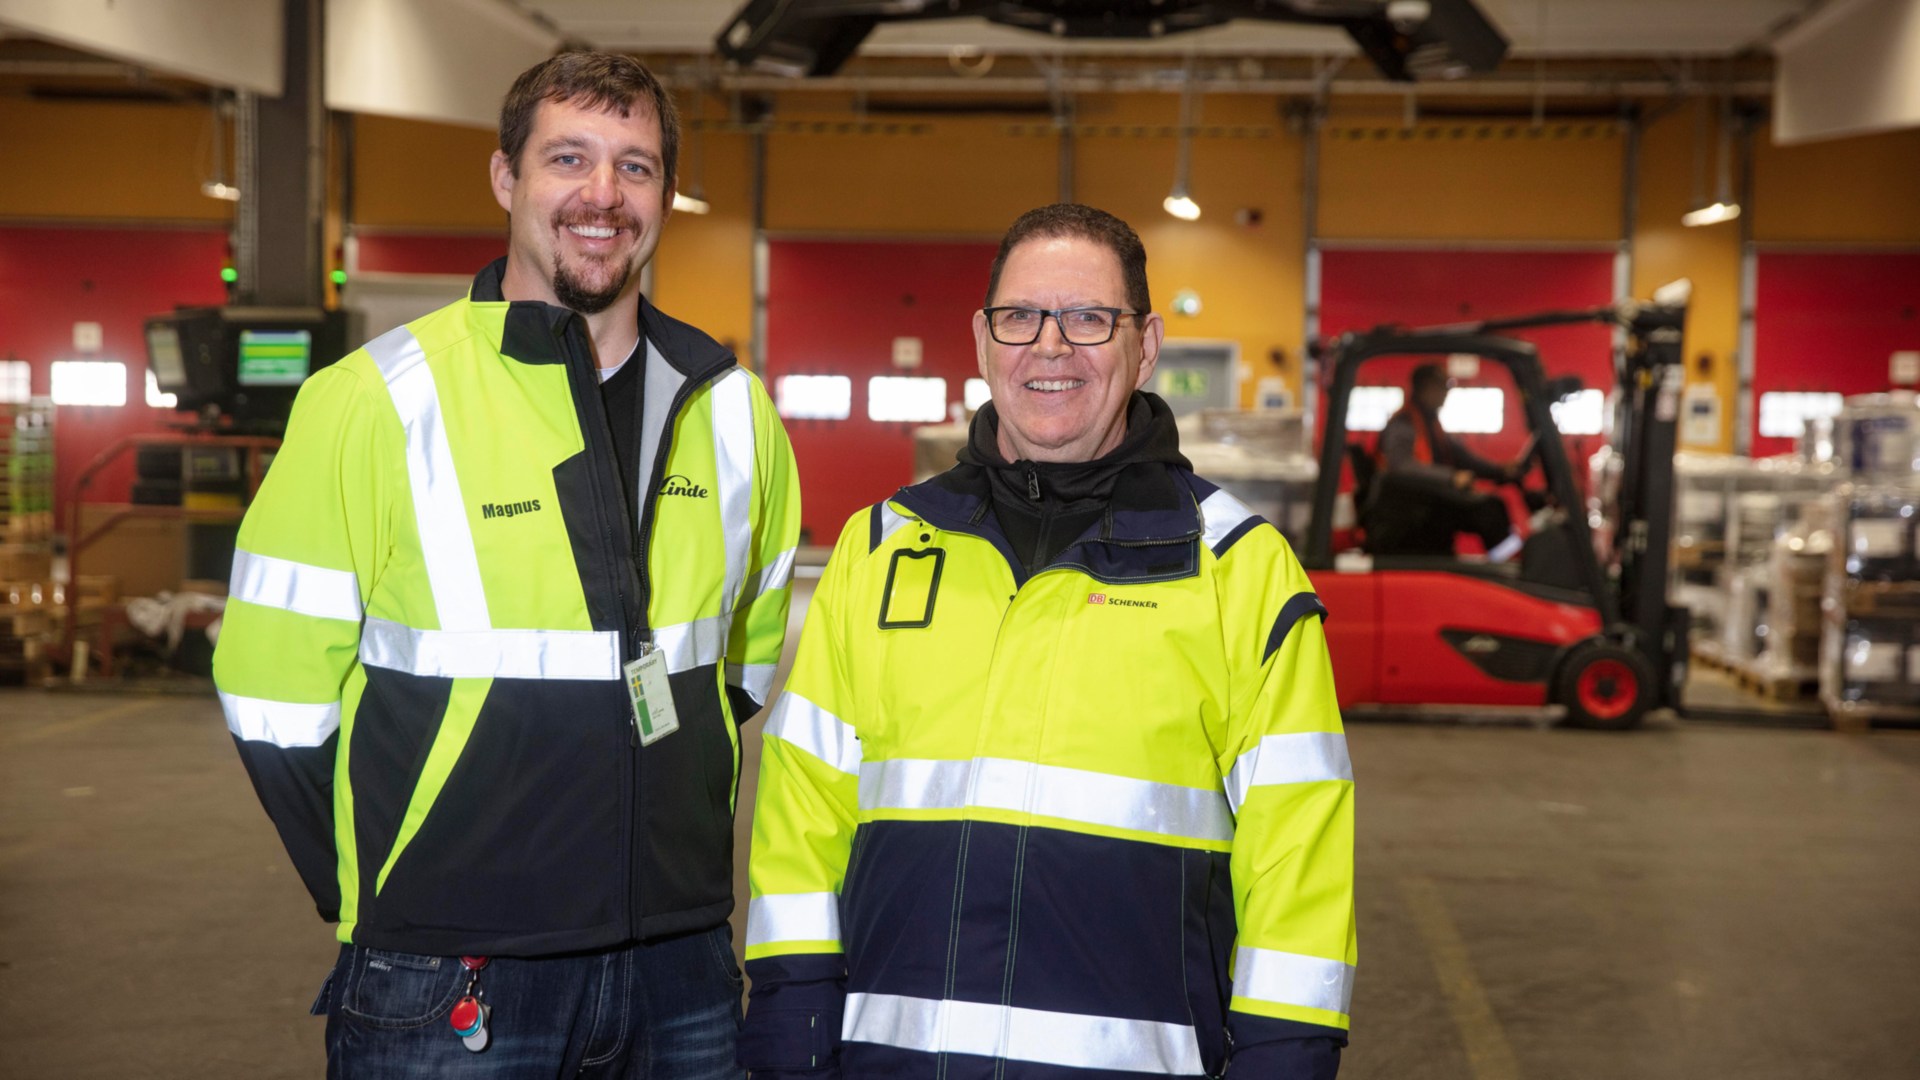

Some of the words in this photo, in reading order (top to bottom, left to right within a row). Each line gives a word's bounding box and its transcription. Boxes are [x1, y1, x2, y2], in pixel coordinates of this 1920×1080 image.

[659, 475, 708, 498] Linde
[482, 499, 541, 519] Magnus
[1089, 593, 1105, 604] DB
[1108, 597, 1158, 609] SCHENKER
